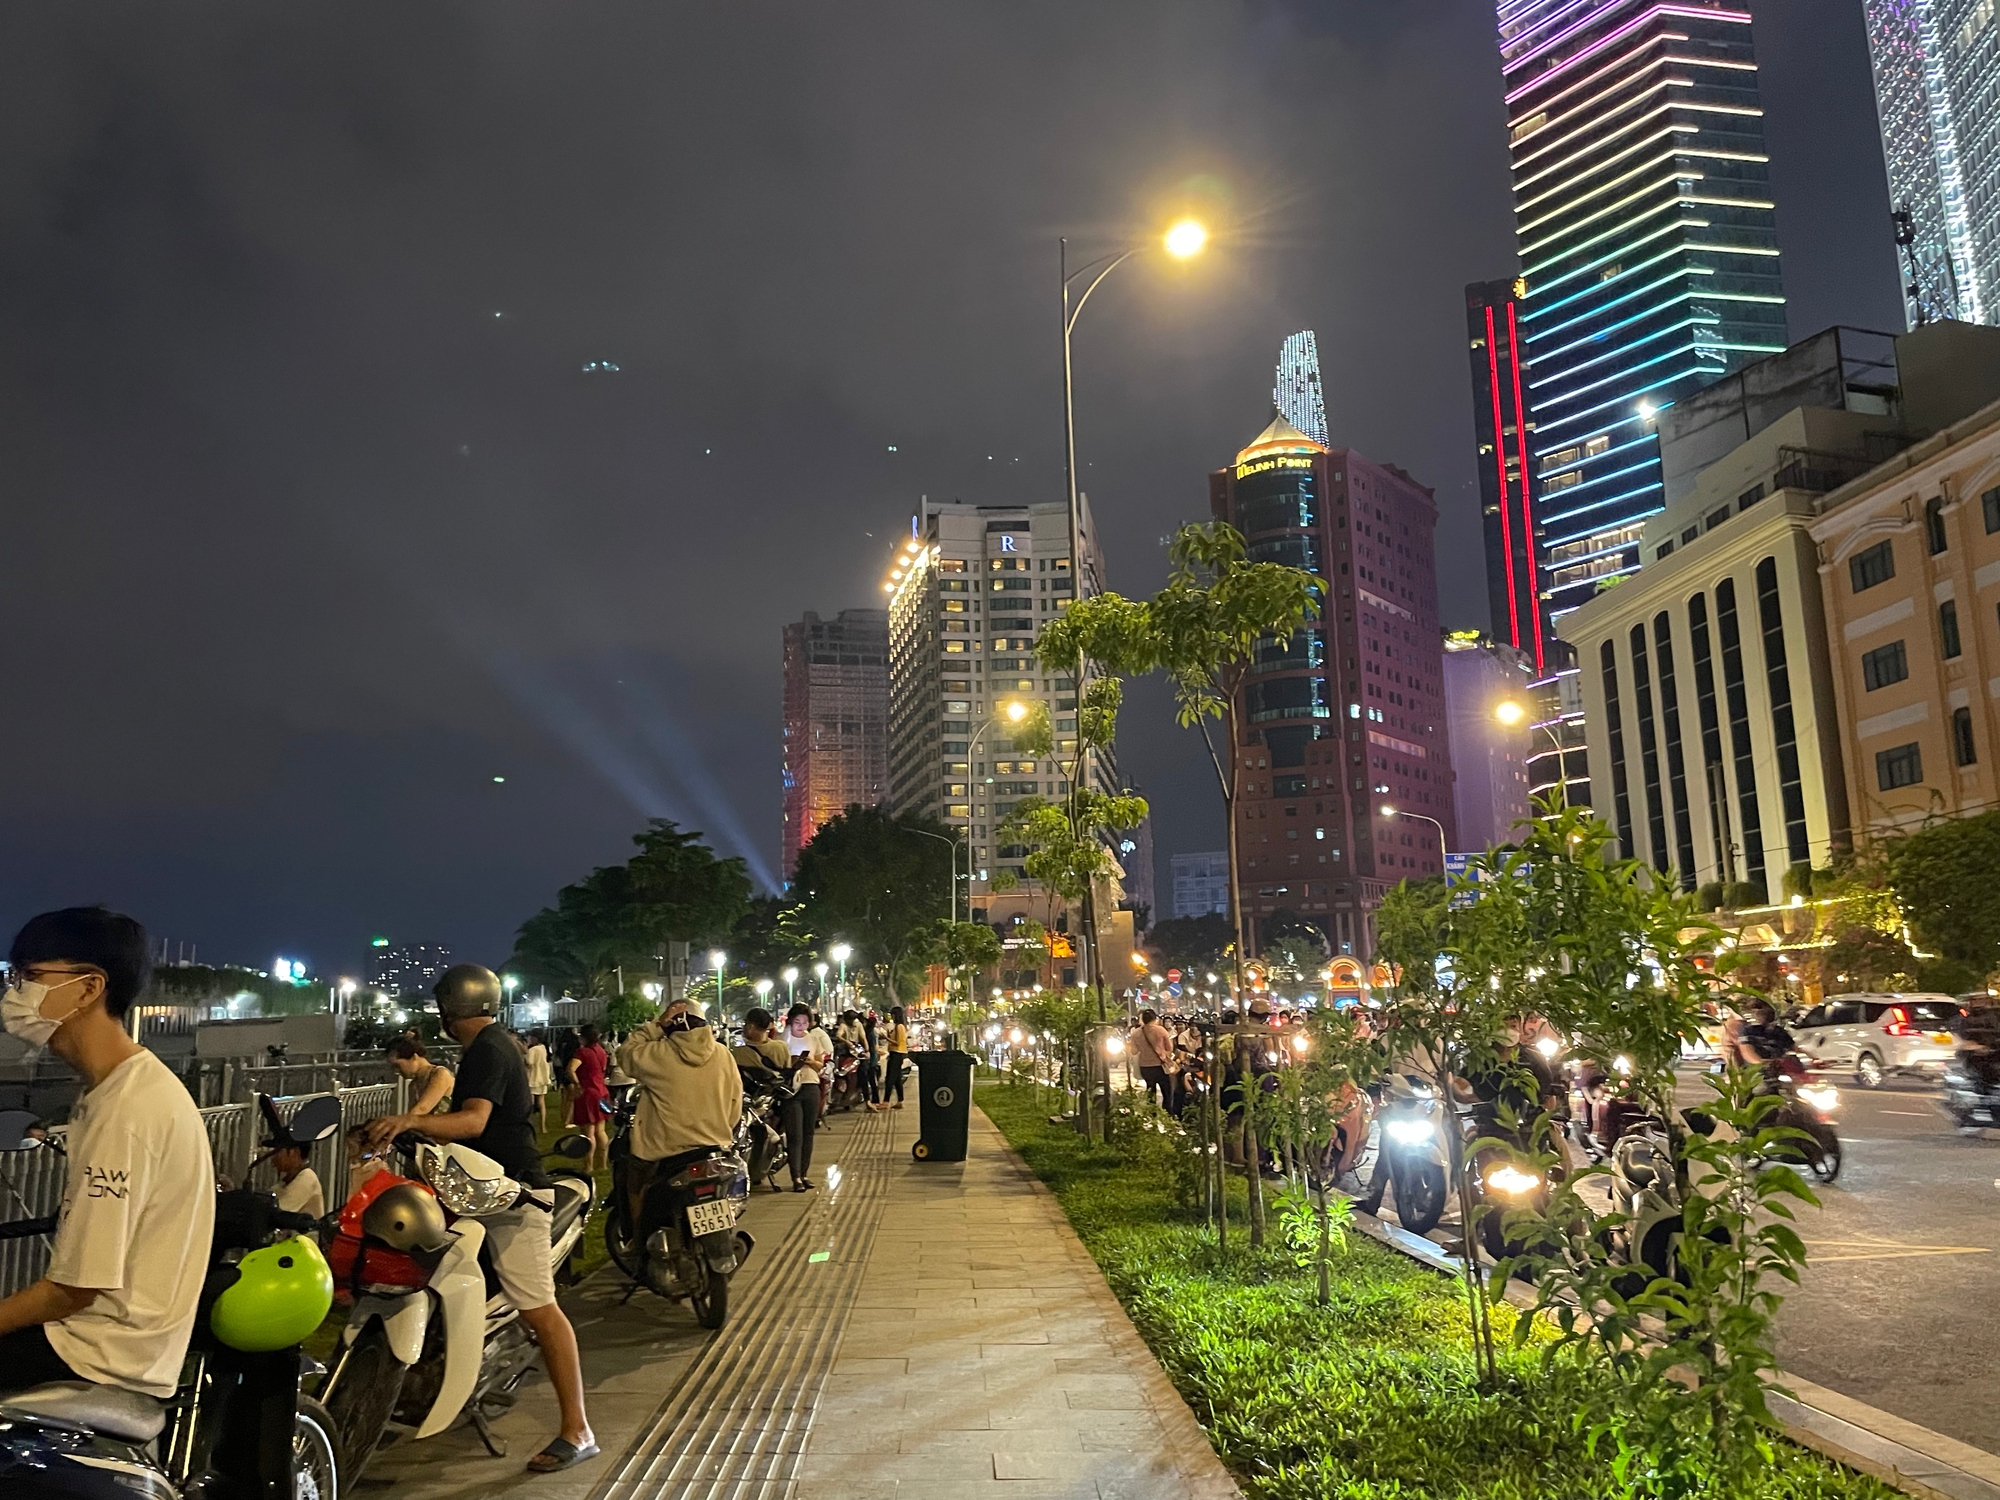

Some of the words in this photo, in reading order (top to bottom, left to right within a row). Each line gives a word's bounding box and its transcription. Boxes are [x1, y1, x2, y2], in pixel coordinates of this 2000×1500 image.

[1236, 460, 1275, 480] MELINH
[1277, 457, 1313, 468] POINT
[1001, 535, 1018, 552] R
[694, 1202, 724, 1219] 61-H1
[693, 1214, 731, 1234] 556.51
